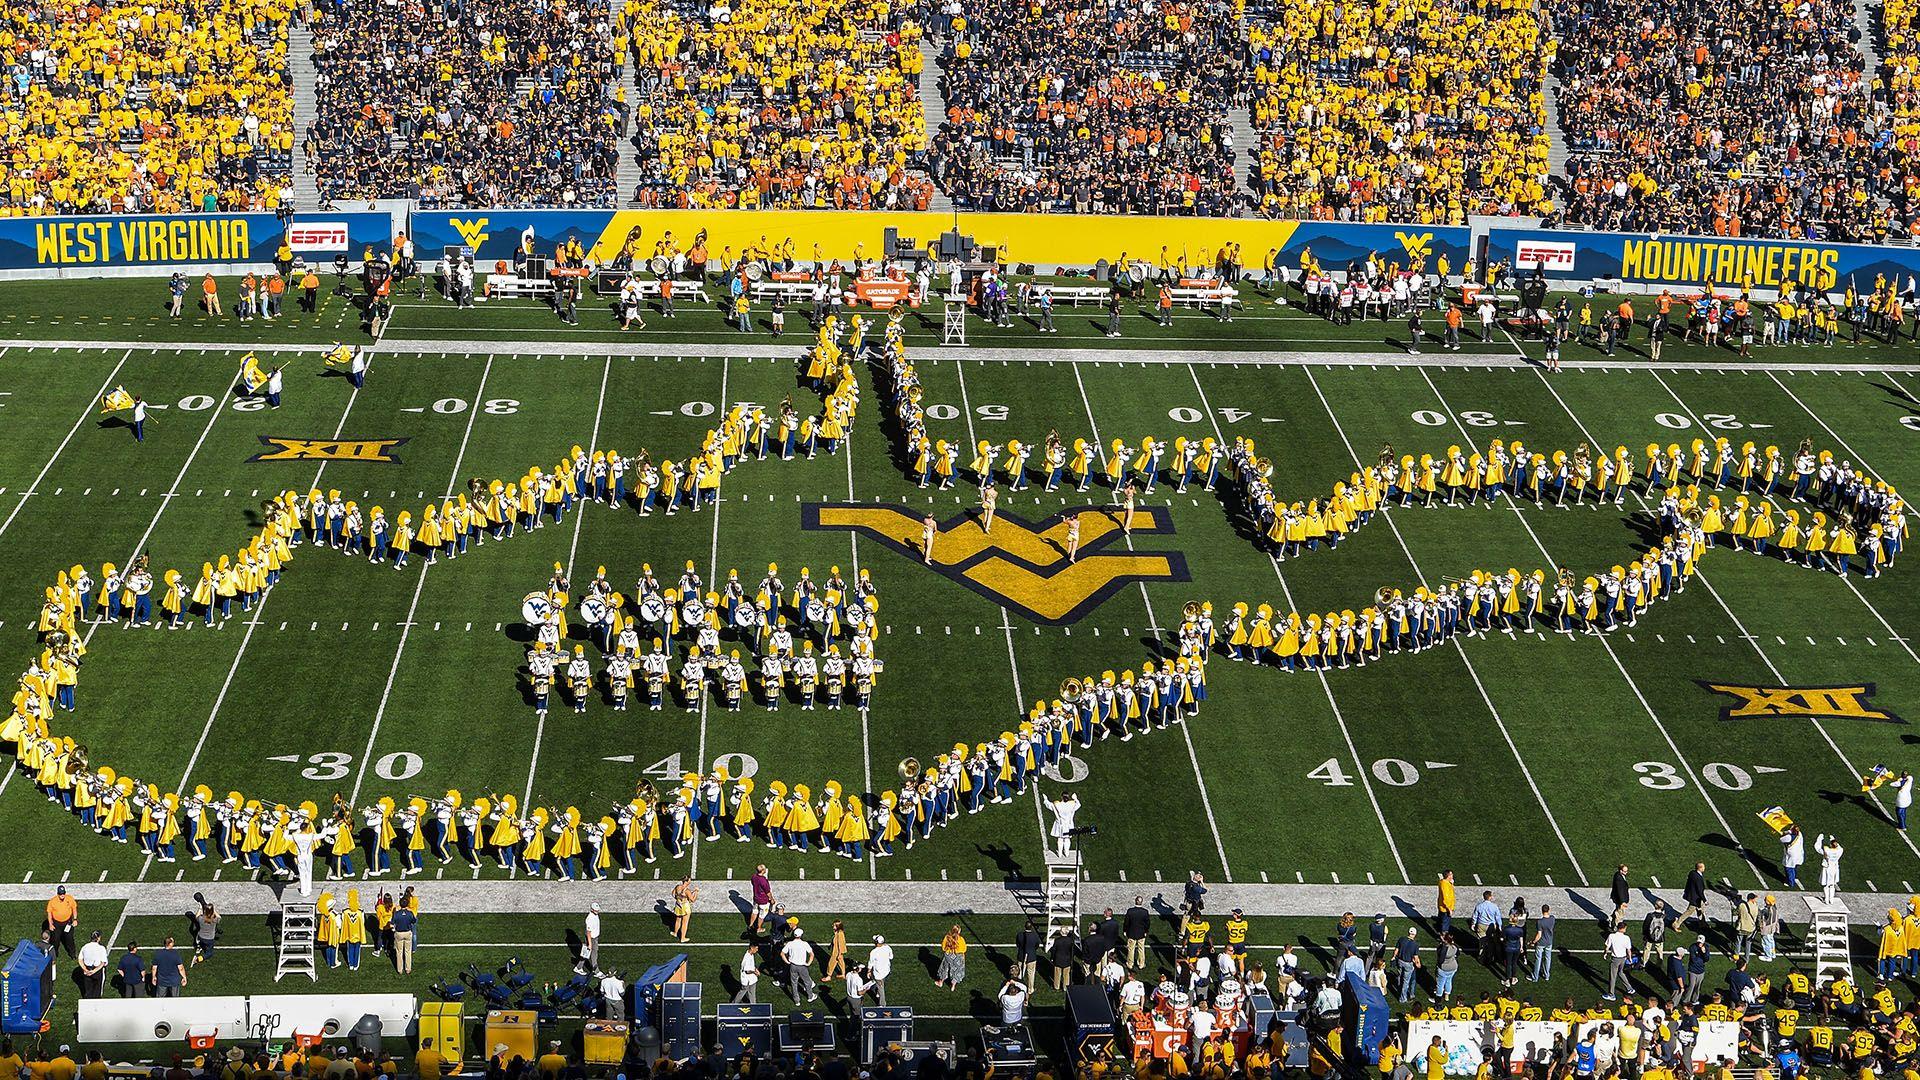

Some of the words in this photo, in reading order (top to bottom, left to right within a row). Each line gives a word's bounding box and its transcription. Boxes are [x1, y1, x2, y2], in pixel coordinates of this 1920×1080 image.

[36, 222, 112, 264] WEST
[119, 219, 250, 262] VIRGINIA
[290, 230, 346, 244] ESPN
[1519, 248, 1573, 263] ESPN
[1621, 239, 1839, 289] MOUNTAINEERS
[255, 437, 402, 462] XII
[1704, 684, 1896, 721] XII
[301, 752, 423, 780] 30
[643, 752, 759, 780] 40
[1307, 757, 1420, 786] 40
[1632, 761, 1753, 790] 30
[1190, 929, 1206, 939] 42
[1797, 978, 1806, 989] 5
[1708, 1009, 1726, 1021] 58
[1779, 1014, 1797, 1026] 49
[196, 1038, 206, 1047] G
[1816, 1032, 1828, 1044] 16
